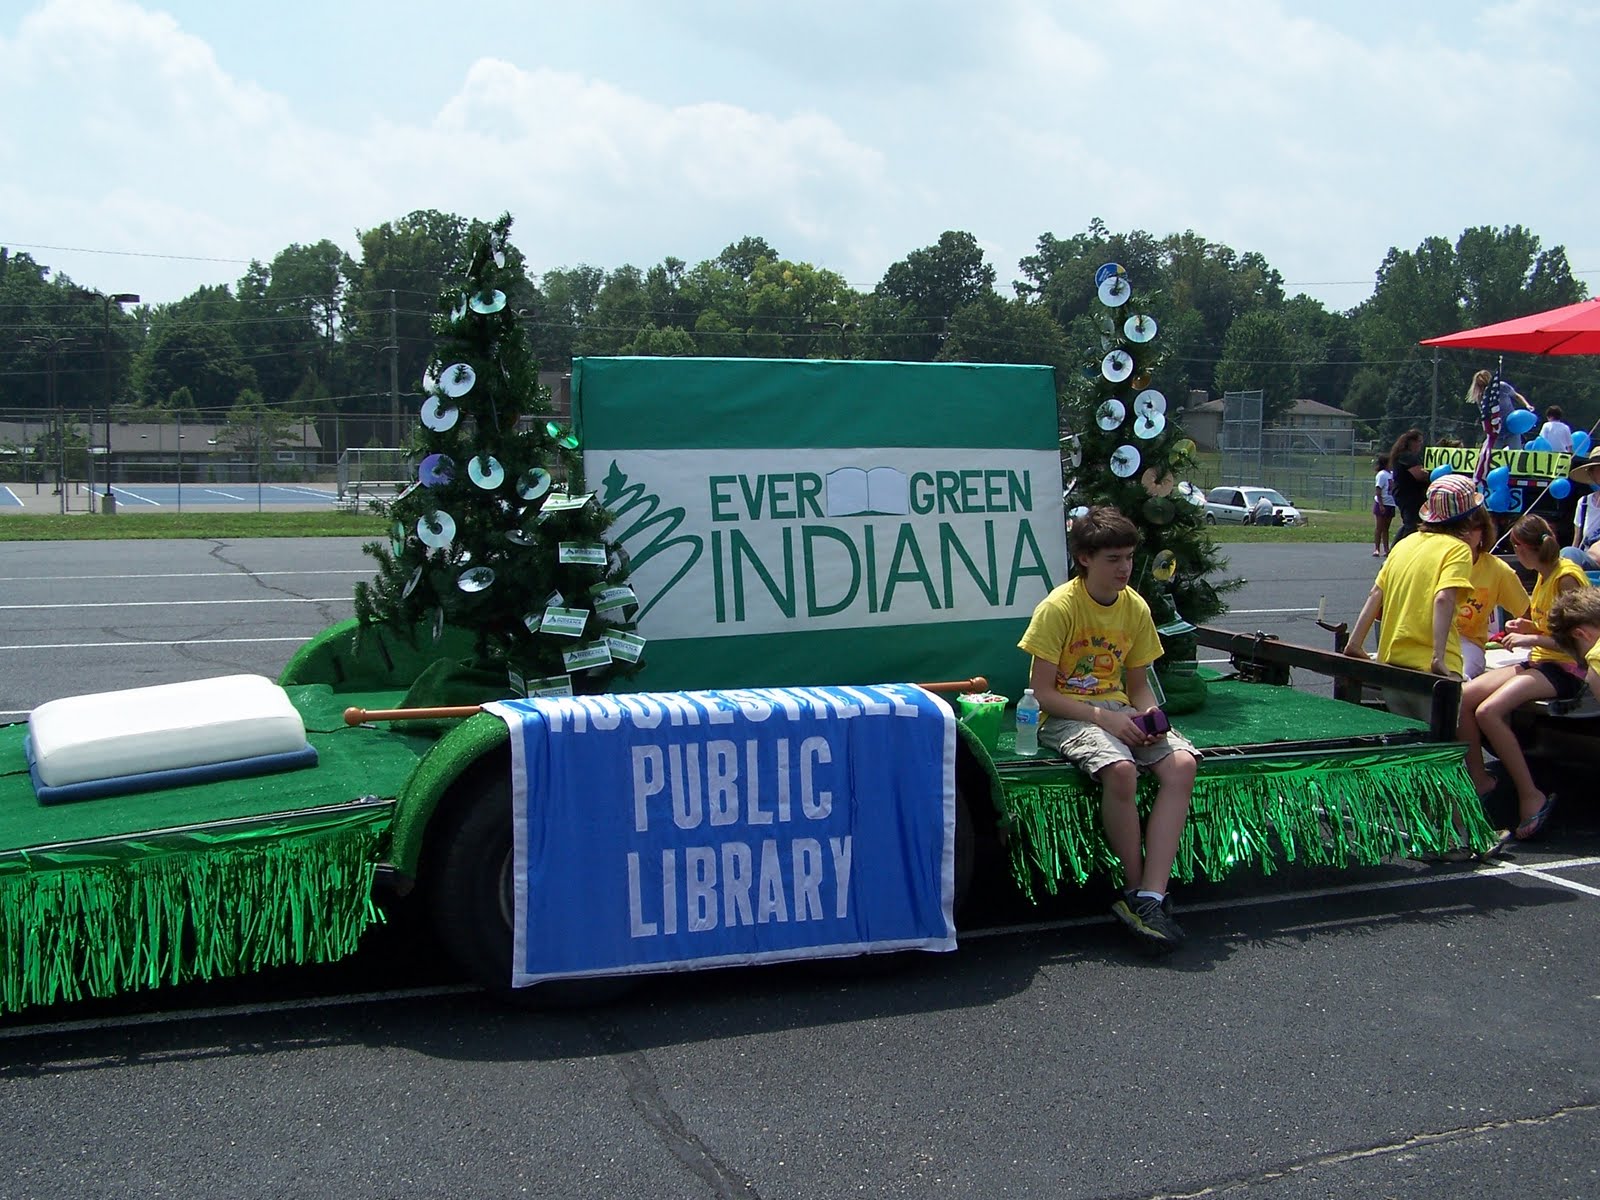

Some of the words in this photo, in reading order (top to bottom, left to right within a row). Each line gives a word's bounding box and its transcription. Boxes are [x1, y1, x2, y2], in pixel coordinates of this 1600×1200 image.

[709, 472, 824, 521] EVER
[909, 469, 1033, 514] GREEN
[1425, 448, 1569, 477] MOORSVILLE
[711, 519, 1054, 623] INDIANA
[546, 684, 919, 733] MOORESVILLE
[631, 736, 832, 832] PUBLIC
[627, 835, 852, 938] LIBRARY
